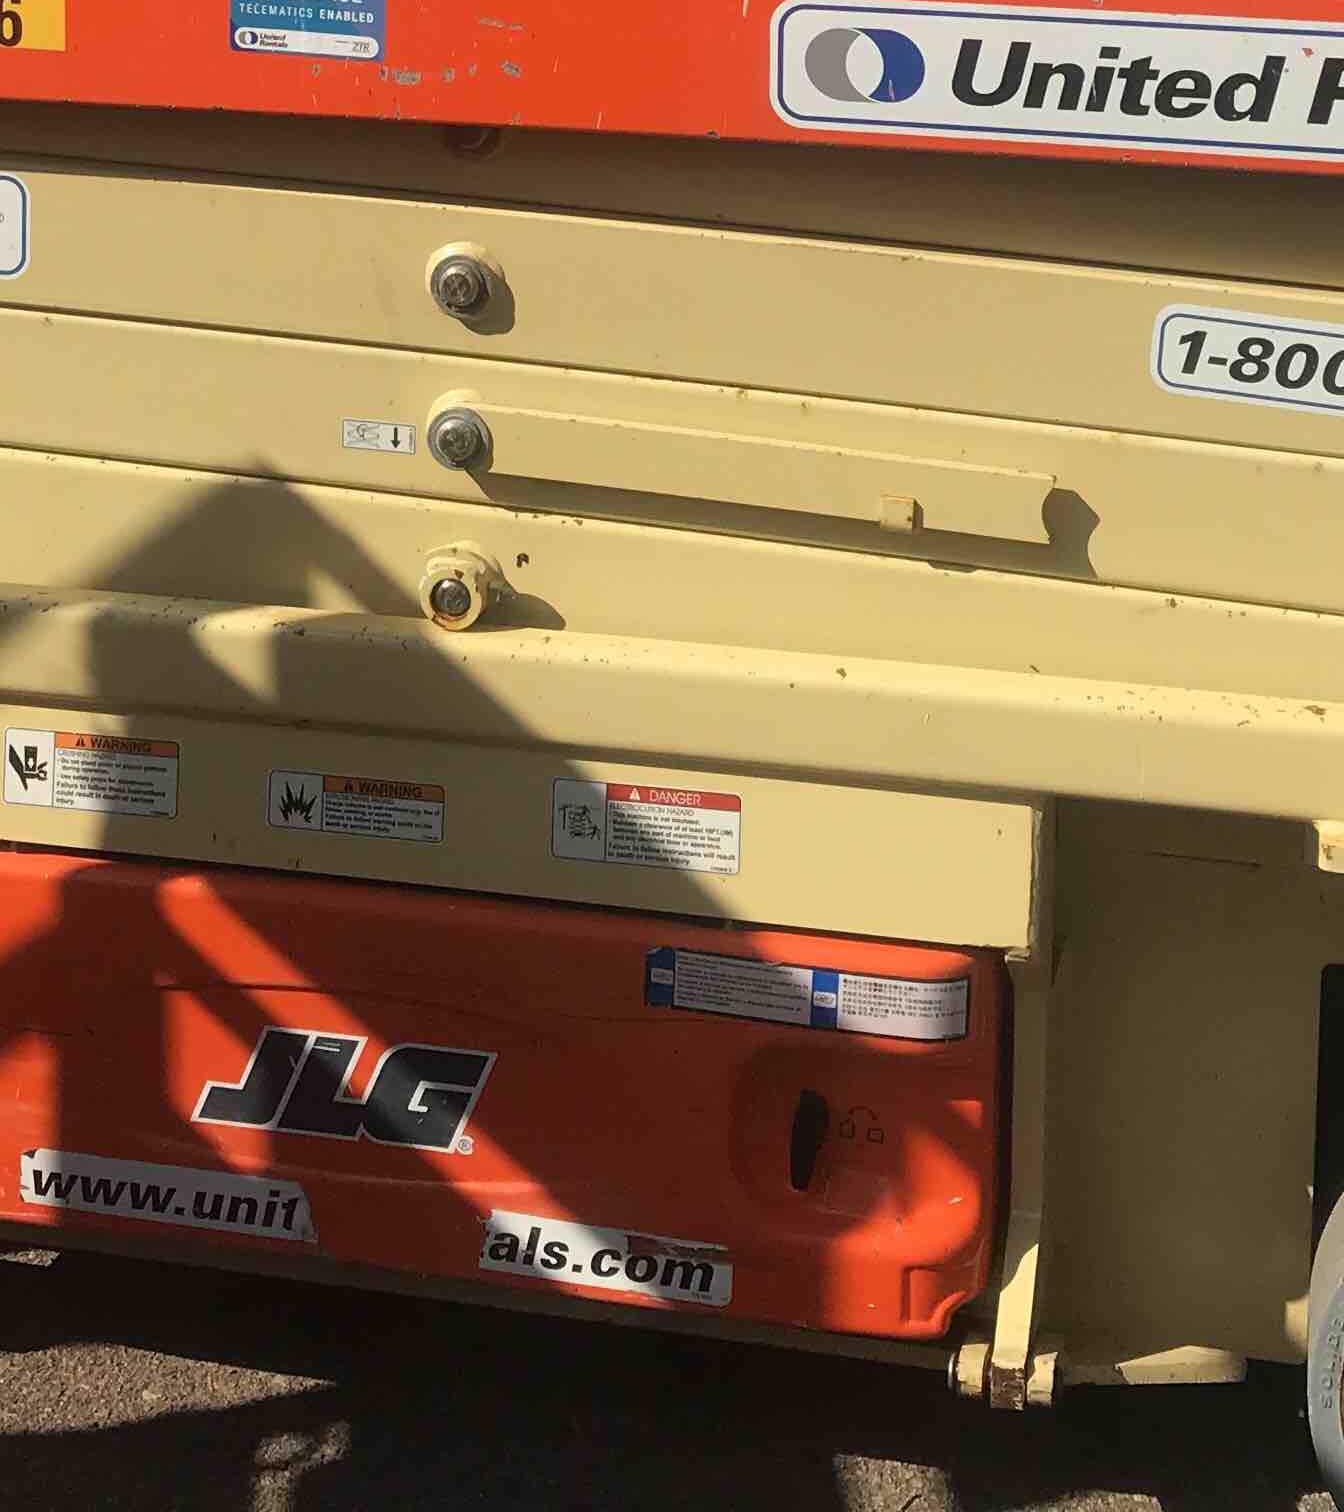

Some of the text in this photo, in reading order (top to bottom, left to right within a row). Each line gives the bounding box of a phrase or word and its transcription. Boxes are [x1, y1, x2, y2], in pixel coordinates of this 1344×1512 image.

[240, 3, 374, 24] TELEMATICS ENABLED
[952, 39, 1289, 125] United
[90, 737, 153, 753] WARNING
[358, 780, 425, 798] WARNING
[649, 789, 703, 806] DANGER
[197, 1028, 497, 1152] JLG
